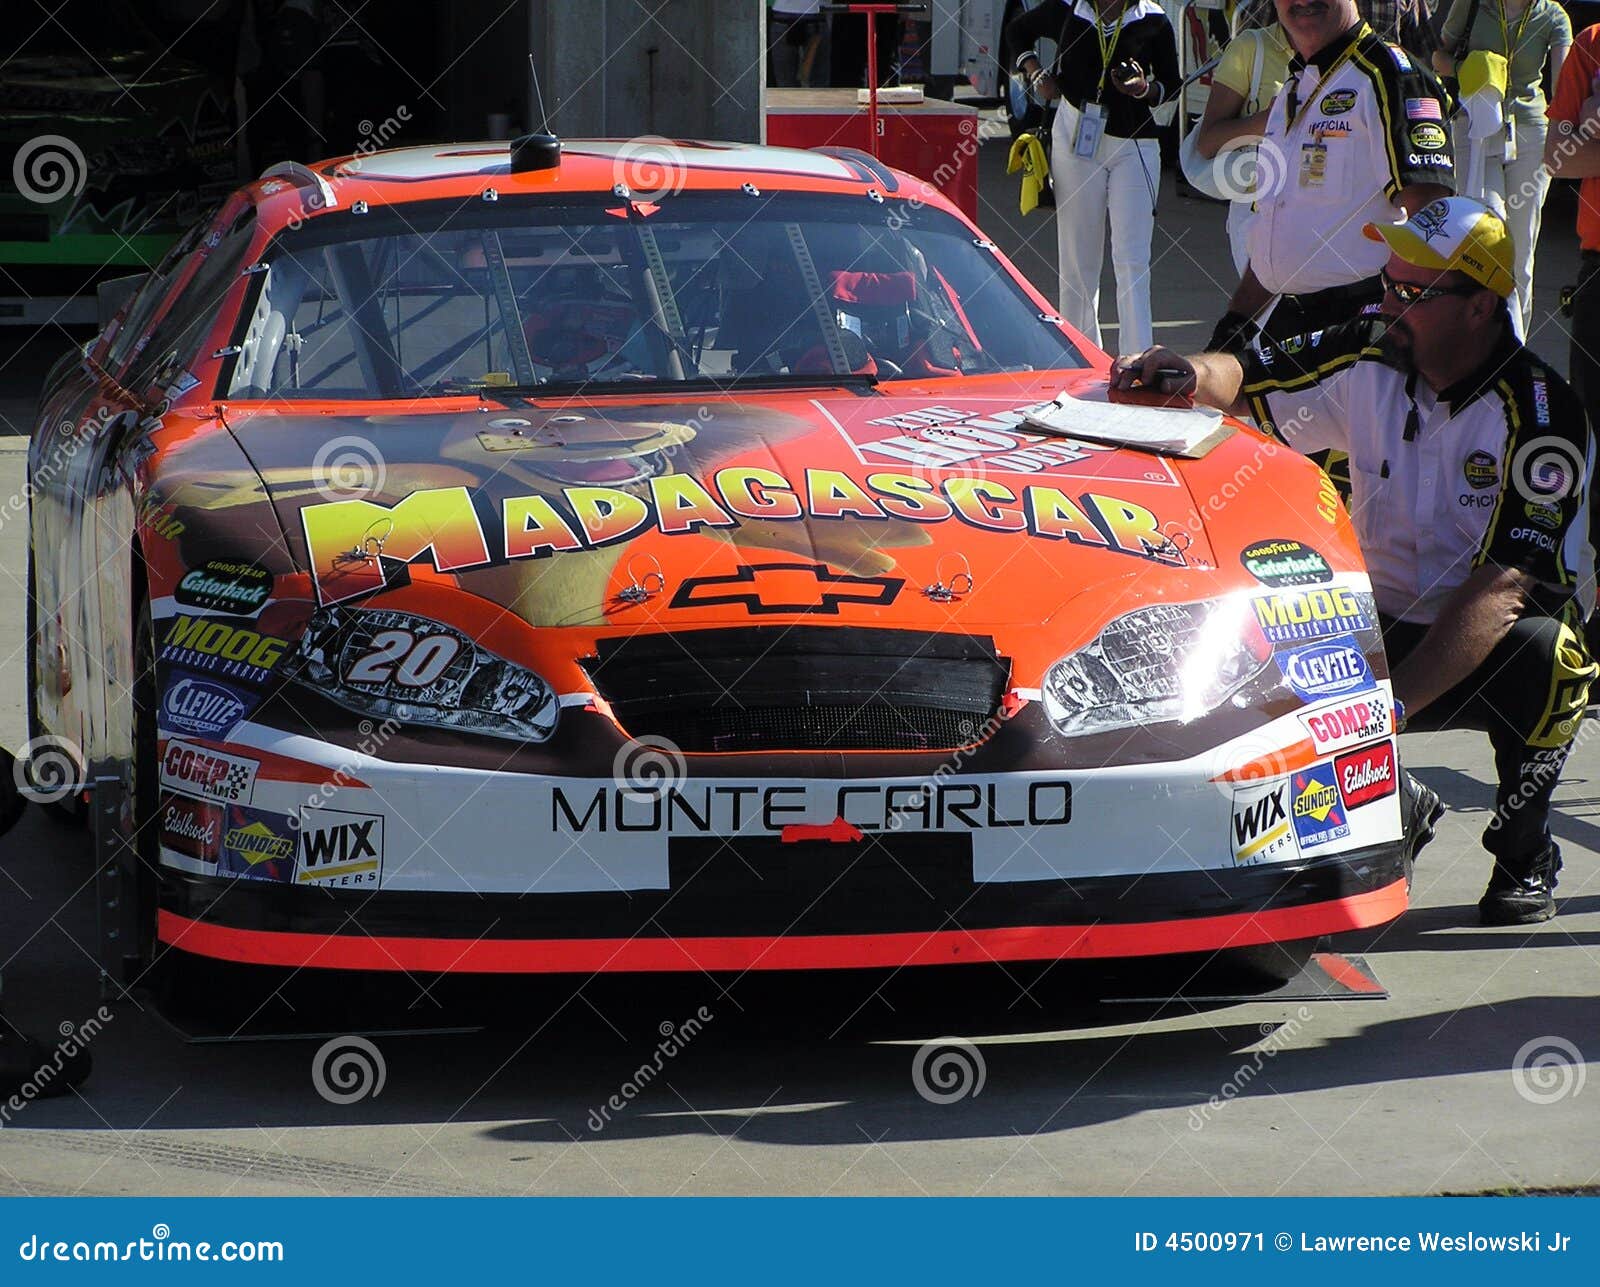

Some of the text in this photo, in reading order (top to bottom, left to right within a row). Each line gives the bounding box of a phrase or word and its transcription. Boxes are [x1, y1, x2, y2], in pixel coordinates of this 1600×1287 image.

[1409, 153, 1453, 168] OFFICIAL
[300, 466, 1188, 607] MADAGASCAR
[1245, 542, 1301, 558] GOODYEAR
[207, 561, 267, 579] GOODYEAR
[1246, 553, 1328, 578] Gatorback
[181, 571, 266, 604] Gatorback
[1253, 587, 1360, 629] MOOG
[162, 615, 289, 670] MOOG
[1267, 616, 1365, 641] CHASSIS PARTS
[161, 645, 271, 682] CHASSIS PARTS
[347, 629, 462, 688] 20
[1287, 648, 1362, 688] CLEVITE
[168, 679, 242, 724] CLEVITE
[1307, 702, 1371, 743] COMP
[1357, 721, 1385, 739] CAMS
[164, 746, 230, 786] COMP
[1343, 755, 1392, 795] Edelbrock
[202, 782, 240, 801] CAMS
[552, 781, 1073, 832] MONTE CARLO
[1295, 787, 1337, 815] SUNOCO
[164, 806, 215, 845] Edelbrock
[1234, 782, 1287, 847] WIX
[225, 830, 292, 858] SUNOCO
[303, 820, 377, 867] WIX
